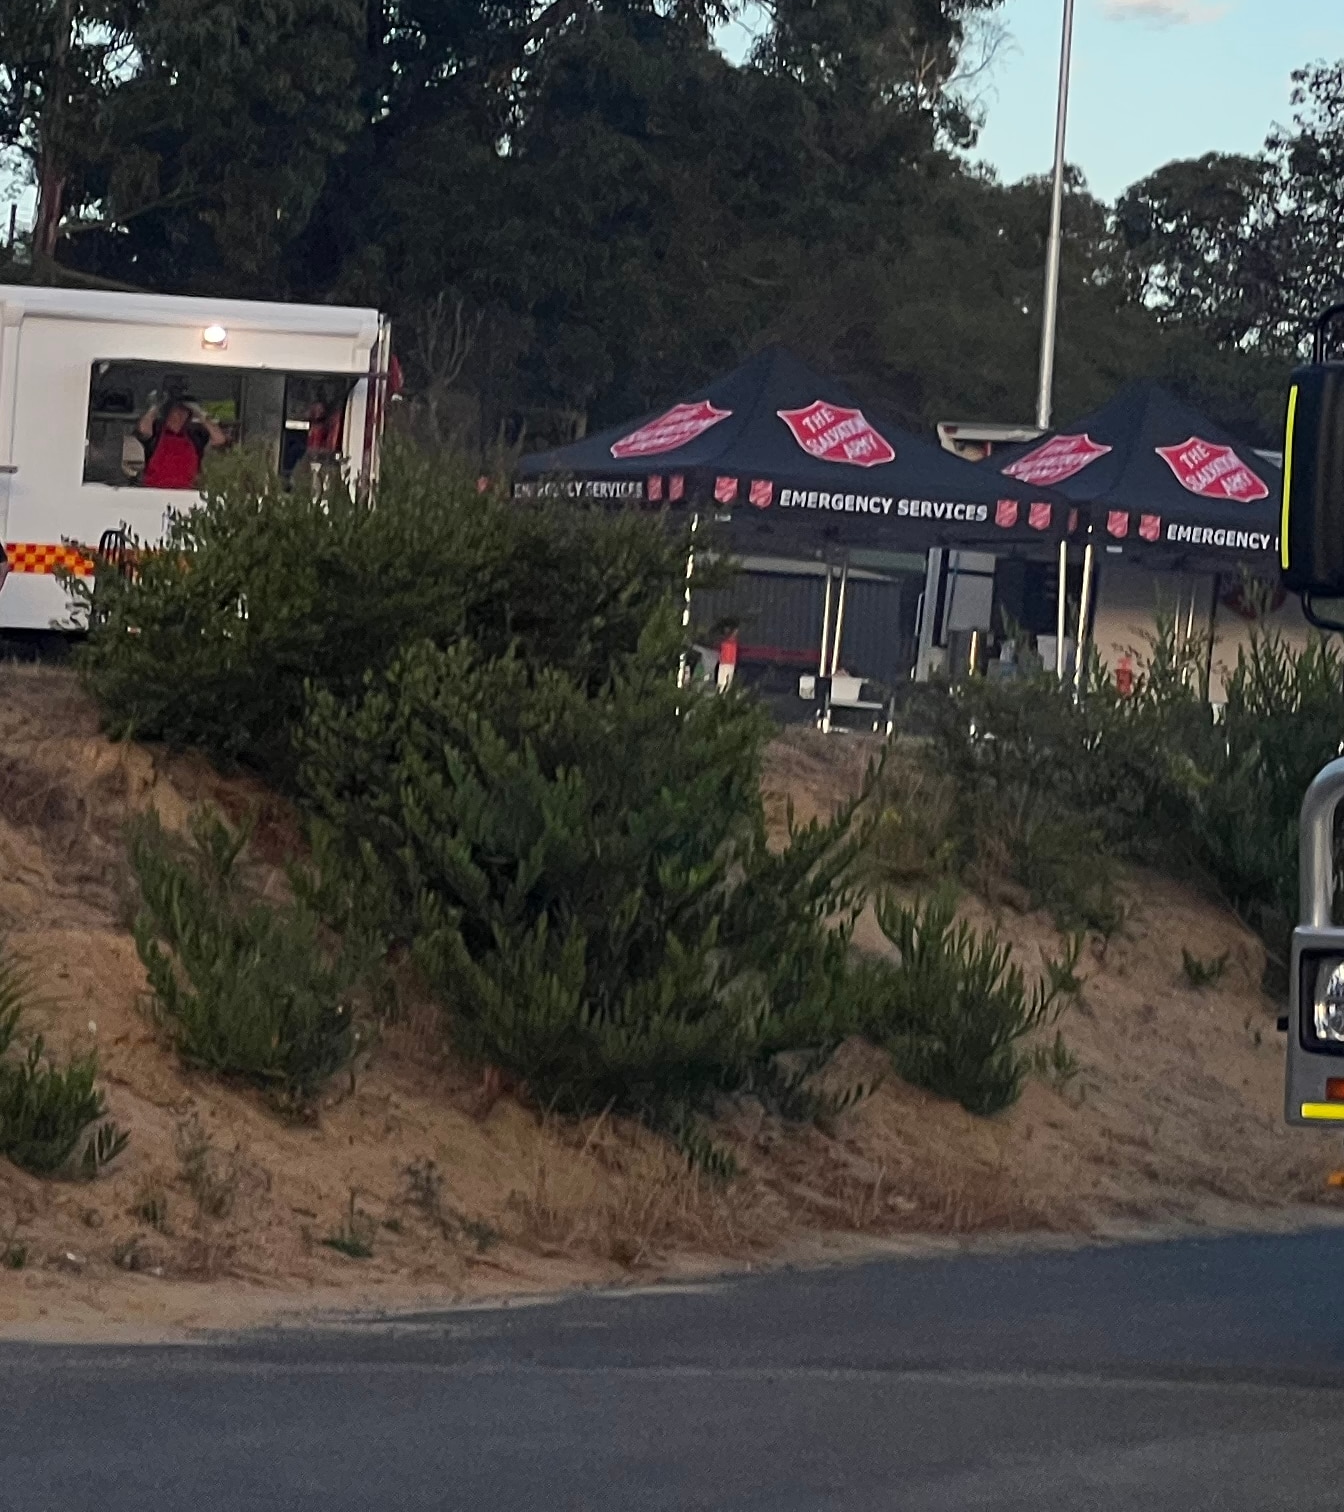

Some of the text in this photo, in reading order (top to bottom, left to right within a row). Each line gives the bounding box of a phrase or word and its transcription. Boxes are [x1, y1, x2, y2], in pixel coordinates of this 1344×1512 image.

[802, 408, 835, 434] THE
[1180, 445, 1210, 469] THE
[779, 489, 988, 522] EMERGENCY SERVICES
[1167, 523, 1270, 550] EMERGENCY
